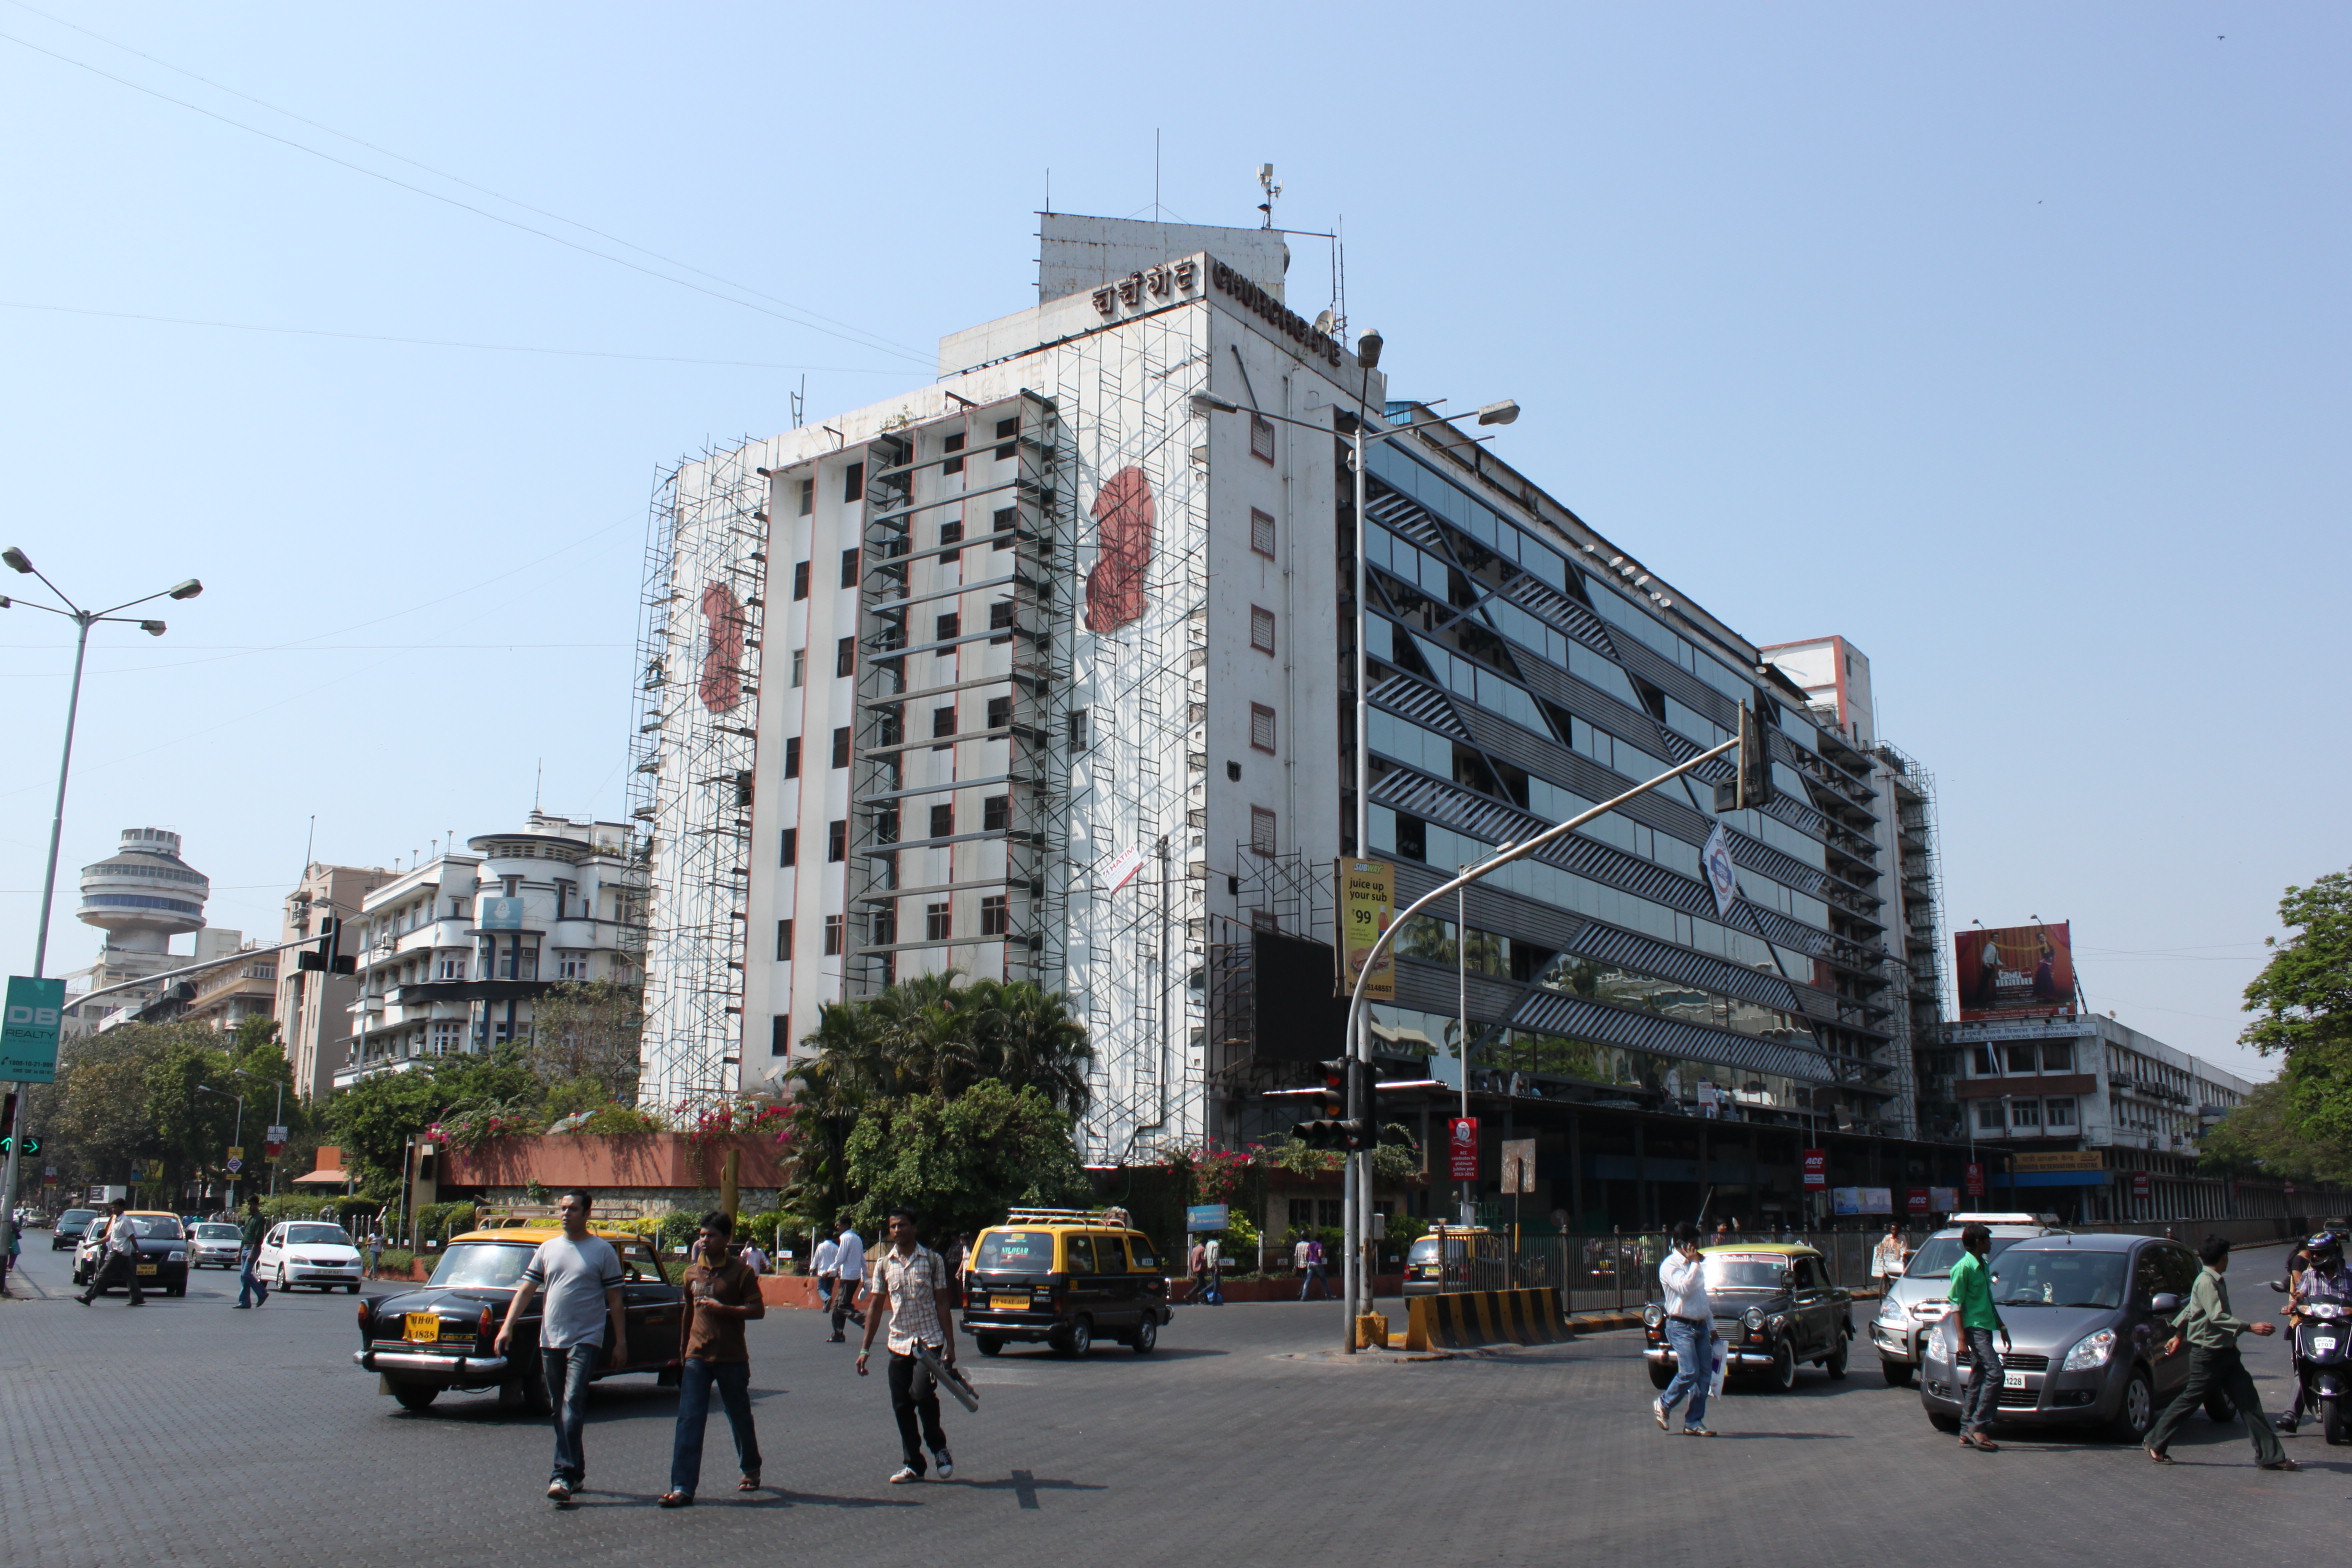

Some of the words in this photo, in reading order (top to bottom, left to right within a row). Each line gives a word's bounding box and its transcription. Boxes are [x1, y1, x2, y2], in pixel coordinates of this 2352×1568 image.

[1211, 260, 1342, 368] CHURCHGATE
[1109, 845, 1135, 871] HATIM
[1353, 862, 1384, 874] SUBWAY
[1349, 877, 1371, 889] juice
[1373, 882, 1384, 891] up
[1349, 890, 1370, 900] your
[1371, 892, 1388, 902] sub
[1364, 983, 1393, 993] 5148557
[6, 1005, 59, 1026] DB
[5, 1028, 56, 1040] REALTY
[1805, 1157, 1824, 1165] ACC
[1908, 1196, 1927, 1204] ACC
